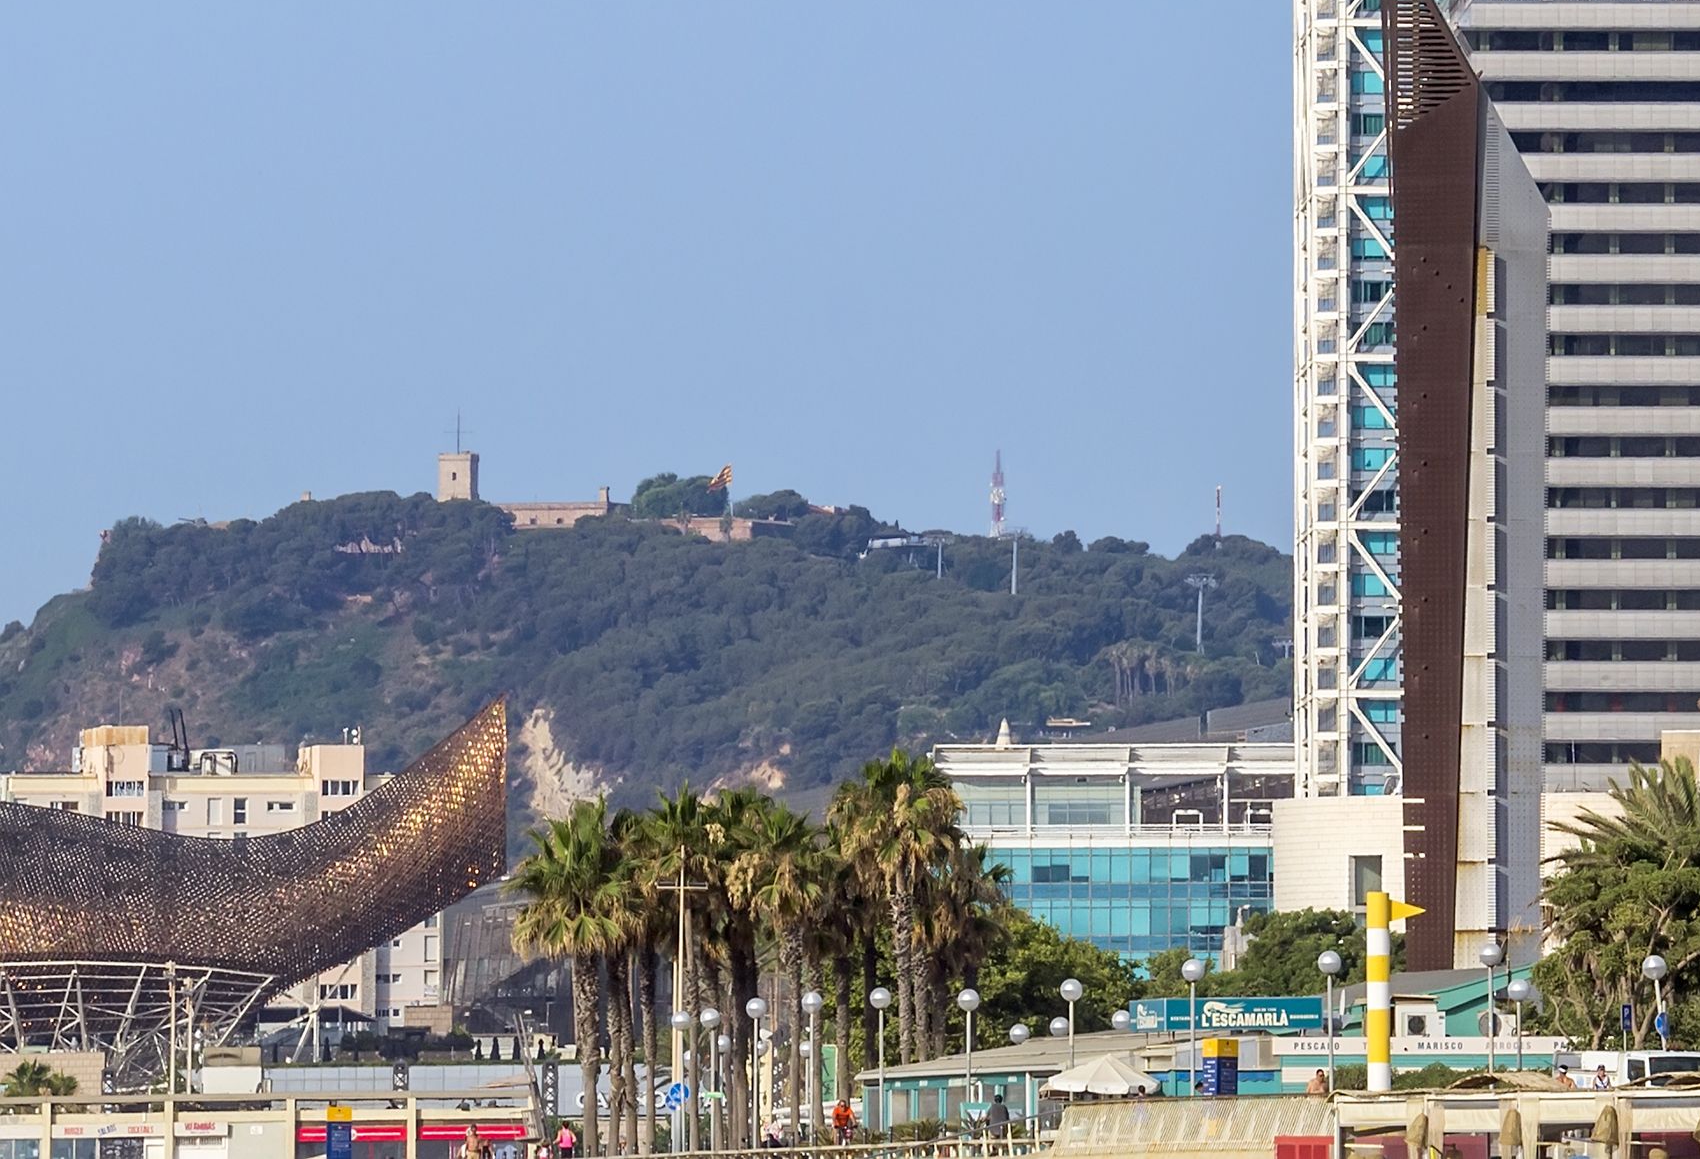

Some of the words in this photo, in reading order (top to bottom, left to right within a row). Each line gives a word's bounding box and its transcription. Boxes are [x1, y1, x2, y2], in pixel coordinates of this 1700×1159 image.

[1201, 1008, 1289, 1028] L'ESCAMARLÀ
[1293, 1042, 1340, 1050] PESCAO
[1417, 1042, 1463, 1050] MARISCO
